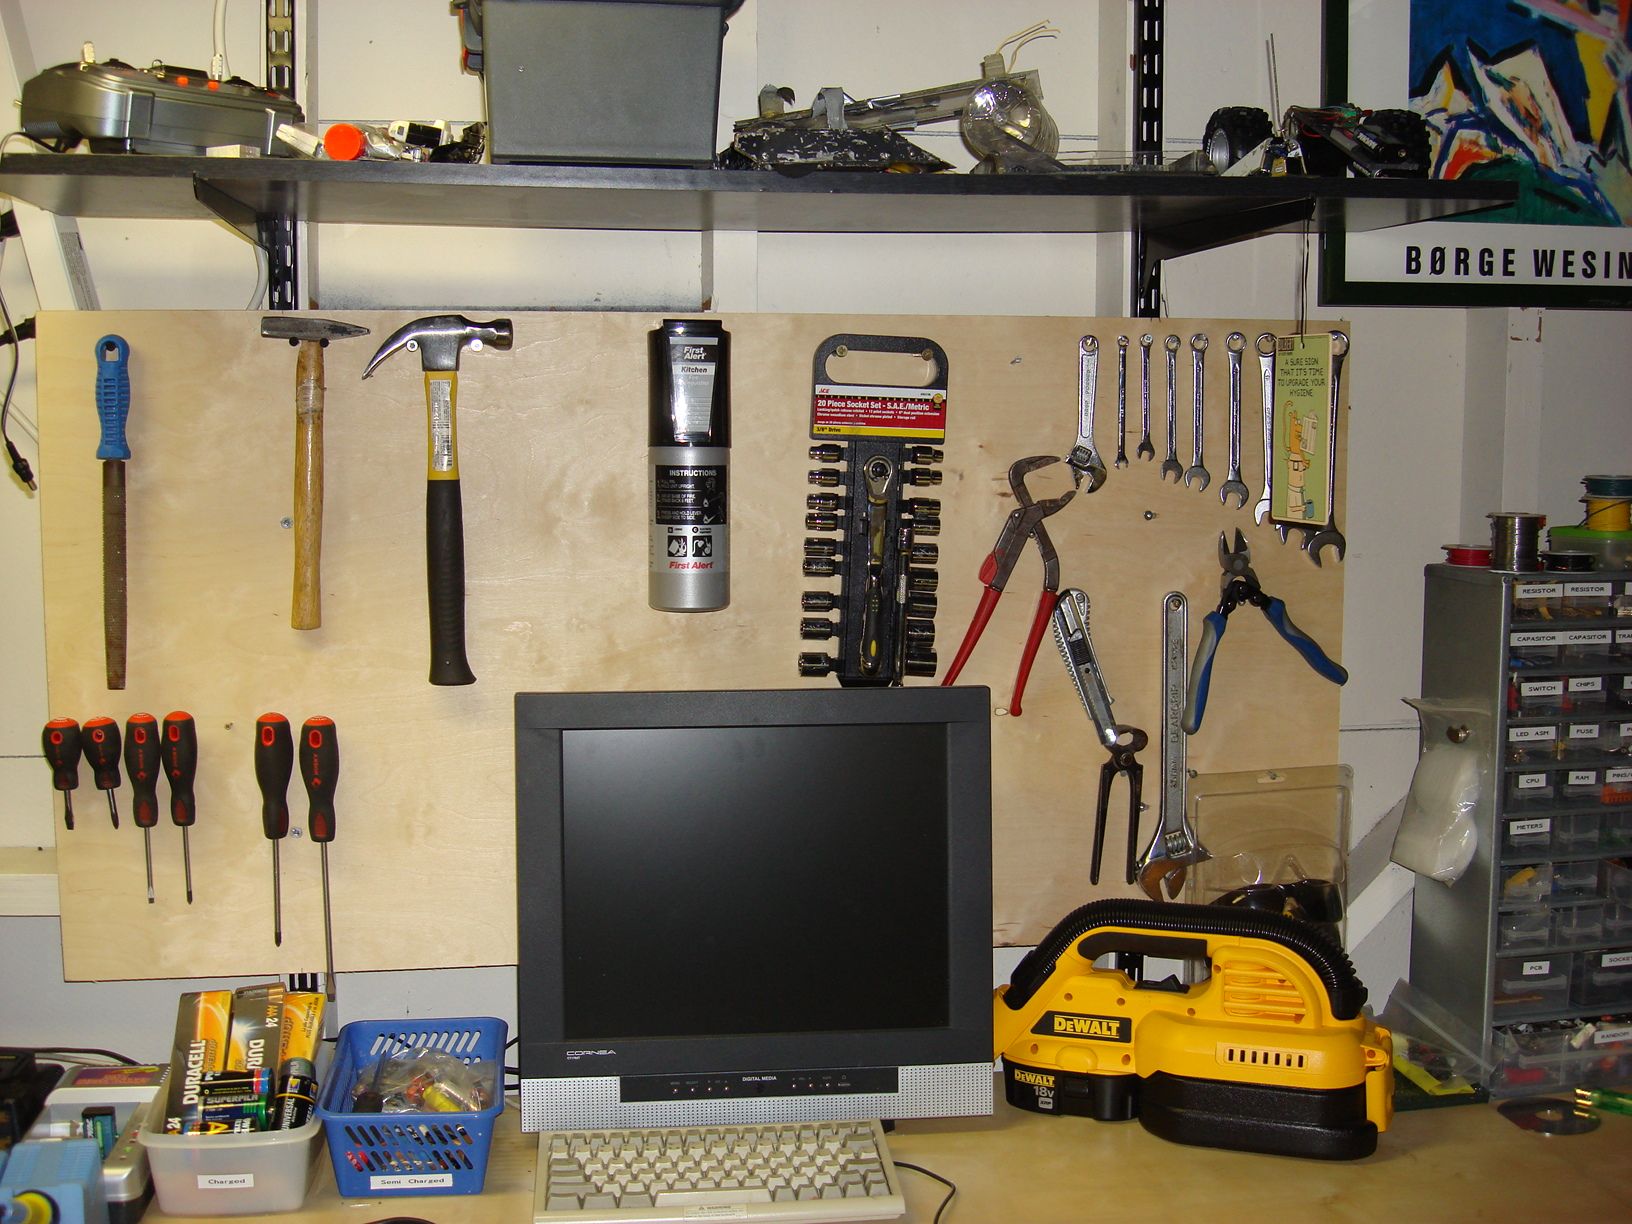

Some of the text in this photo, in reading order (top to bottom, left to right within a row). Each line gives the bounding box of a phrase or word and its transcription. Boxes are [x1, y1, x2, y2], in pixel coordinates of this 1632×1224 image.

[1405, 245, 1516, 277] BØRGE
[683, 346, 704, 354] First
[684, 352, 706, 360] Alert
[1290, 358, 1303, 366] SURE
[1305, 357, 1319, 366] SIGN
[1280, 368, 1294, 376] THAT
[1309, 368, 1325, 376] TIME
[1286, 378, 1309, 387] UPGRADE
[1311, 378, 1326, 386] YOUR
[827, 400, 846, 408] Piece
[846, 401, 870, 409] Socket
[669, 469, 717, 477] INSTRUCTIONS
[668, 561, 714, 569] First Alert
[265, 1018, 279, 1028] 24
[182, 1039, 206, 1105] DURACELL
[167, 1117, 181, 1129] 24
[408, 1177, 446, 1185] Charged
